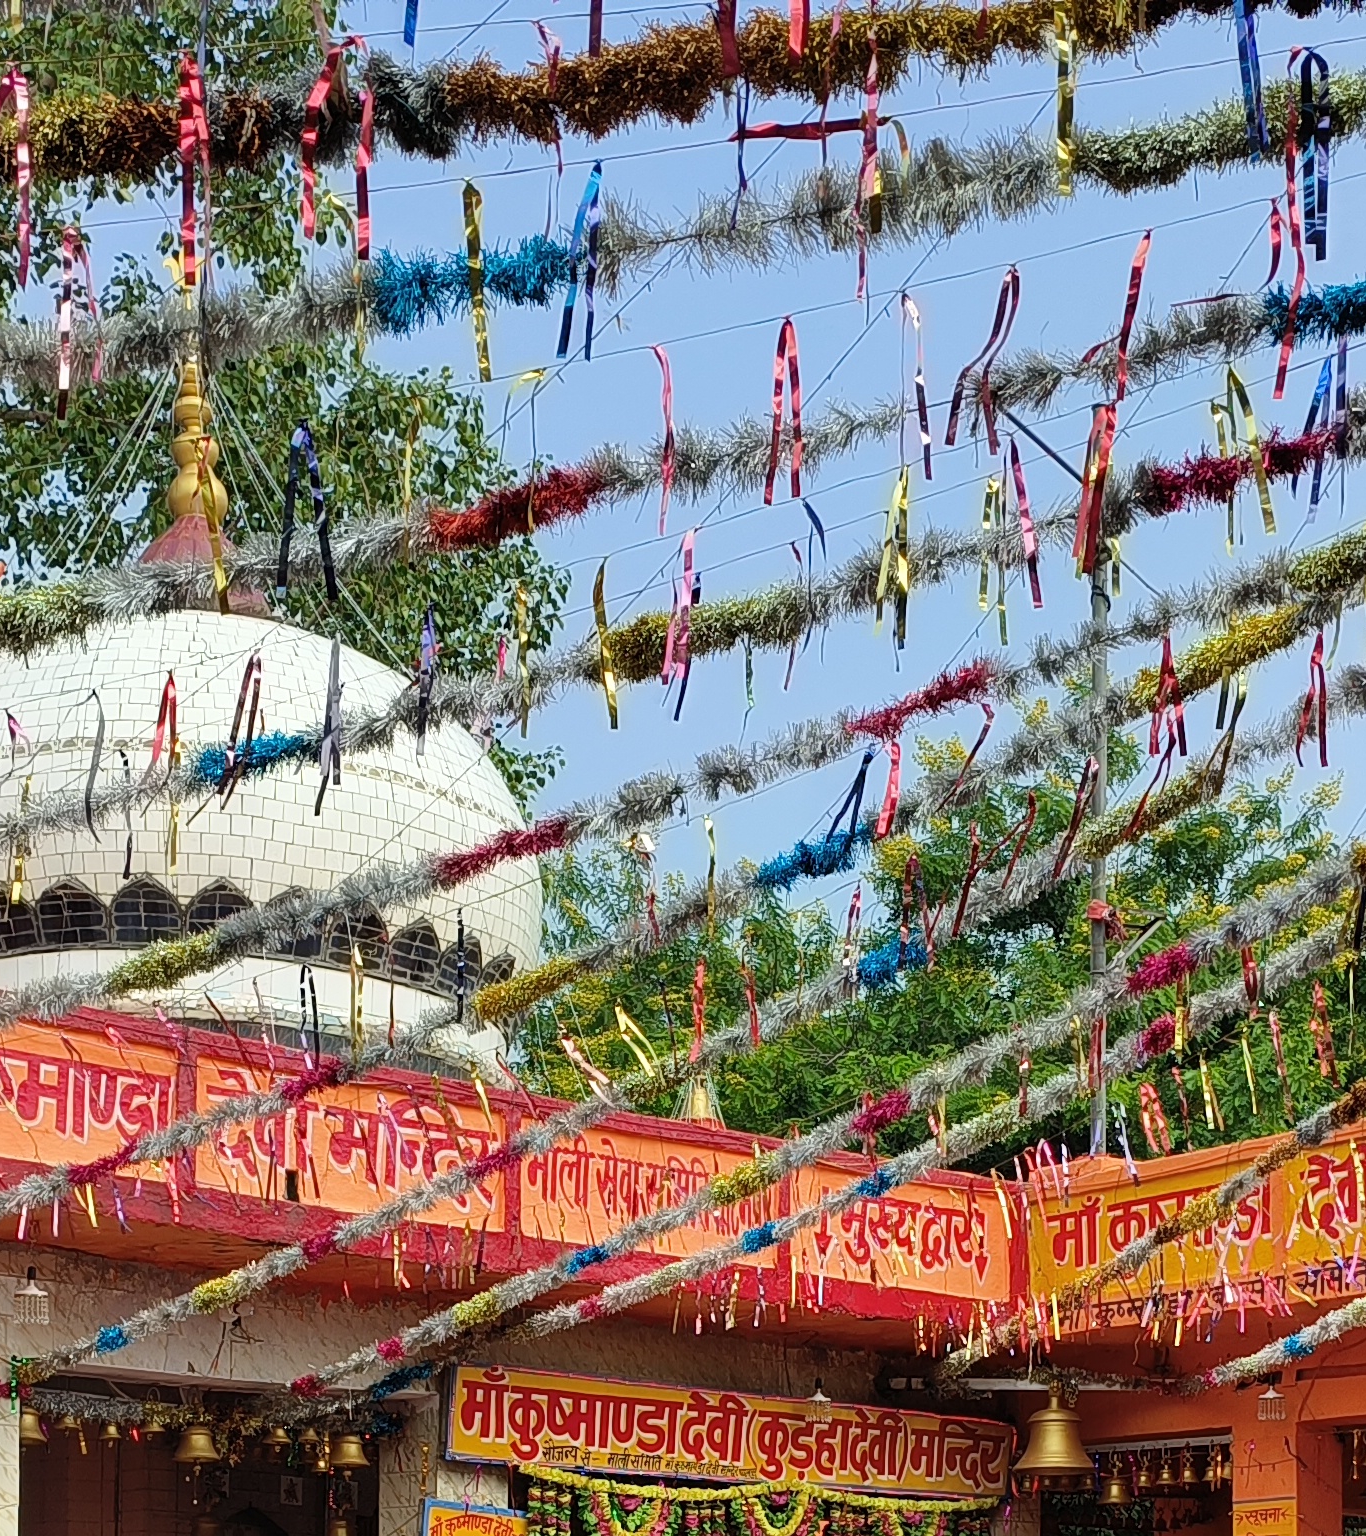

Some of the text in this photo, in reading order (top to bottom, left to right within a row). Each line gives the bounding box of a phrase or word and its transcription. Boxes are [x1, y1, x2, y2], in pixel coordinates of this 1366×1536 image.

[460, 1366, 511, 1441] माँ
[681, 1391, 747, 1463] देवी
[908, 1417, 1009, 1490] मन्दिर
[1244, 1507, 1283, 1528] सूचना
